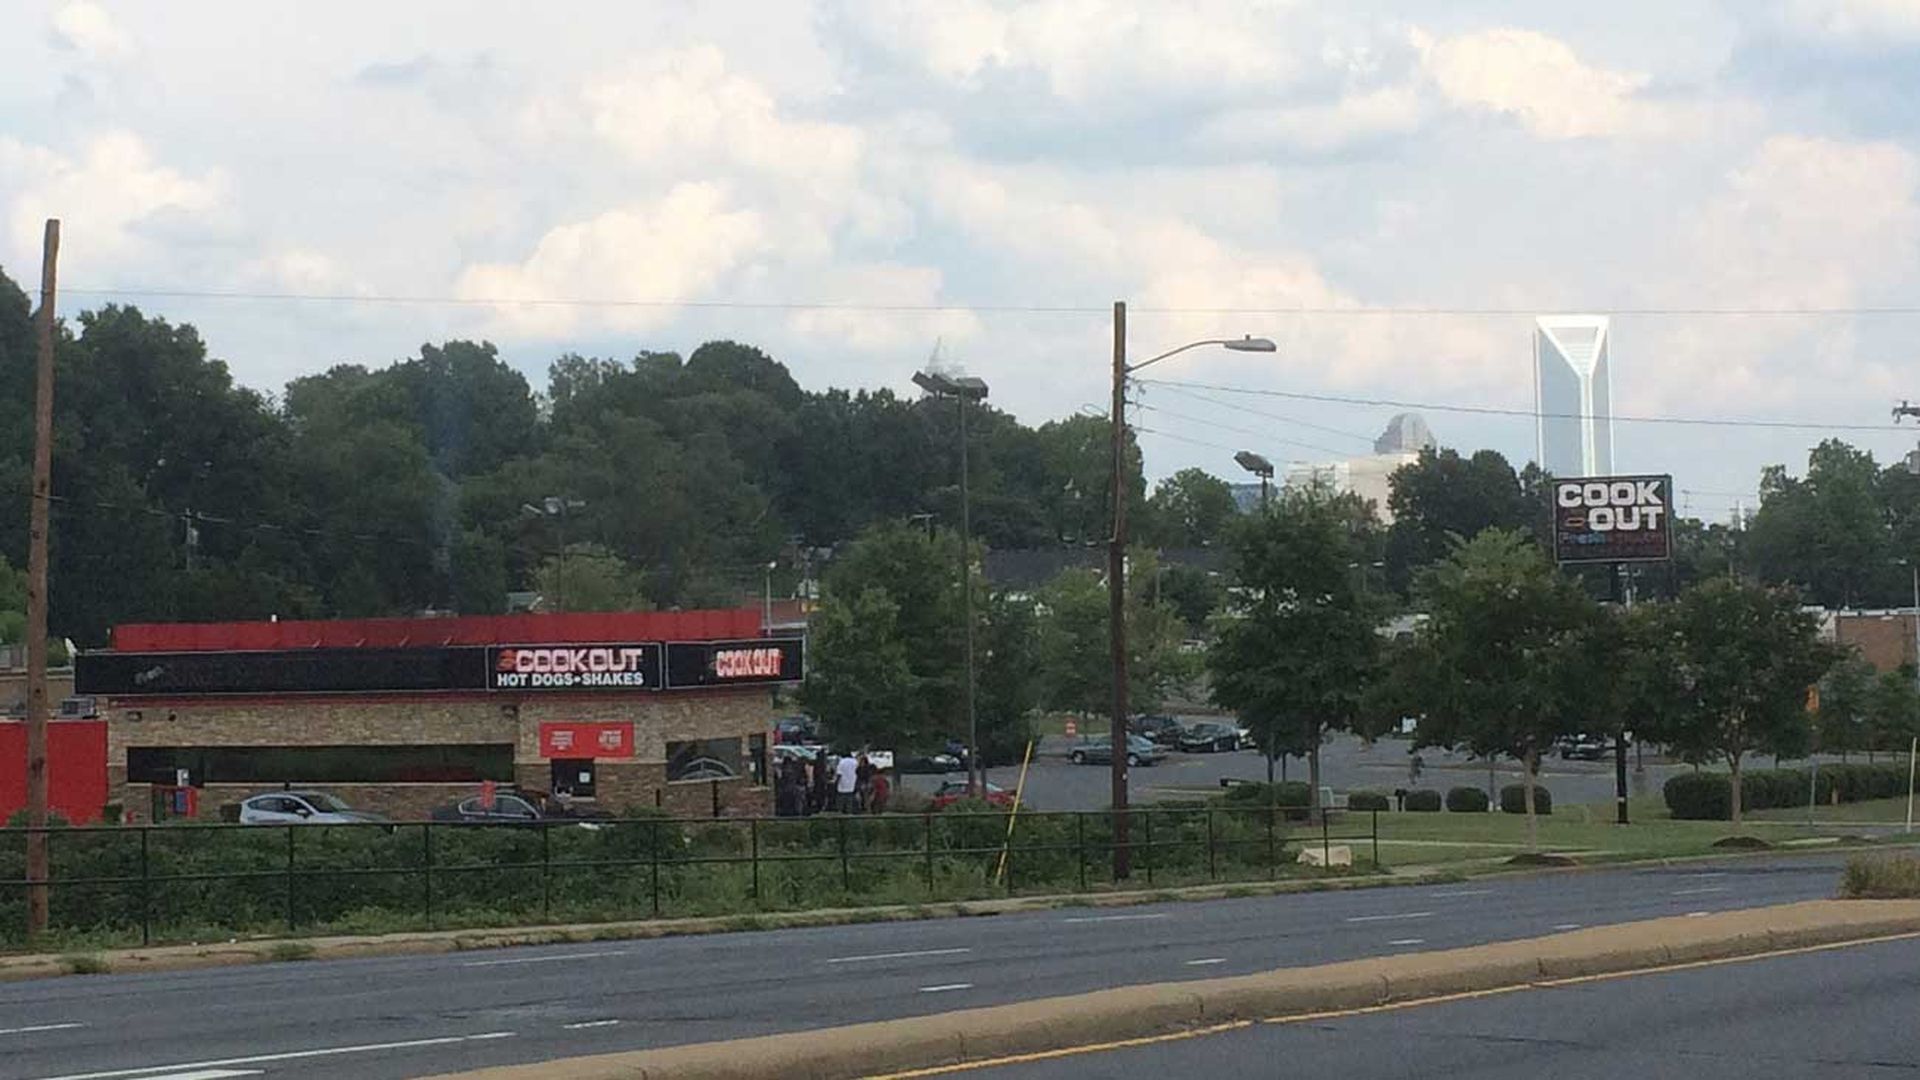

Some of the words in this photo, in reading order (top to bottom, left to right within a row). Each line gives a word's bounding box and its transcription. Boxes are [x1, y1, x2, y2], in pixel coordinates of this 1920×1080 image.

[1558, 481, 1662, 507] COOK
[1588, 506, 1664, 531] OUT
[497, 673, 528, 687] HOT
